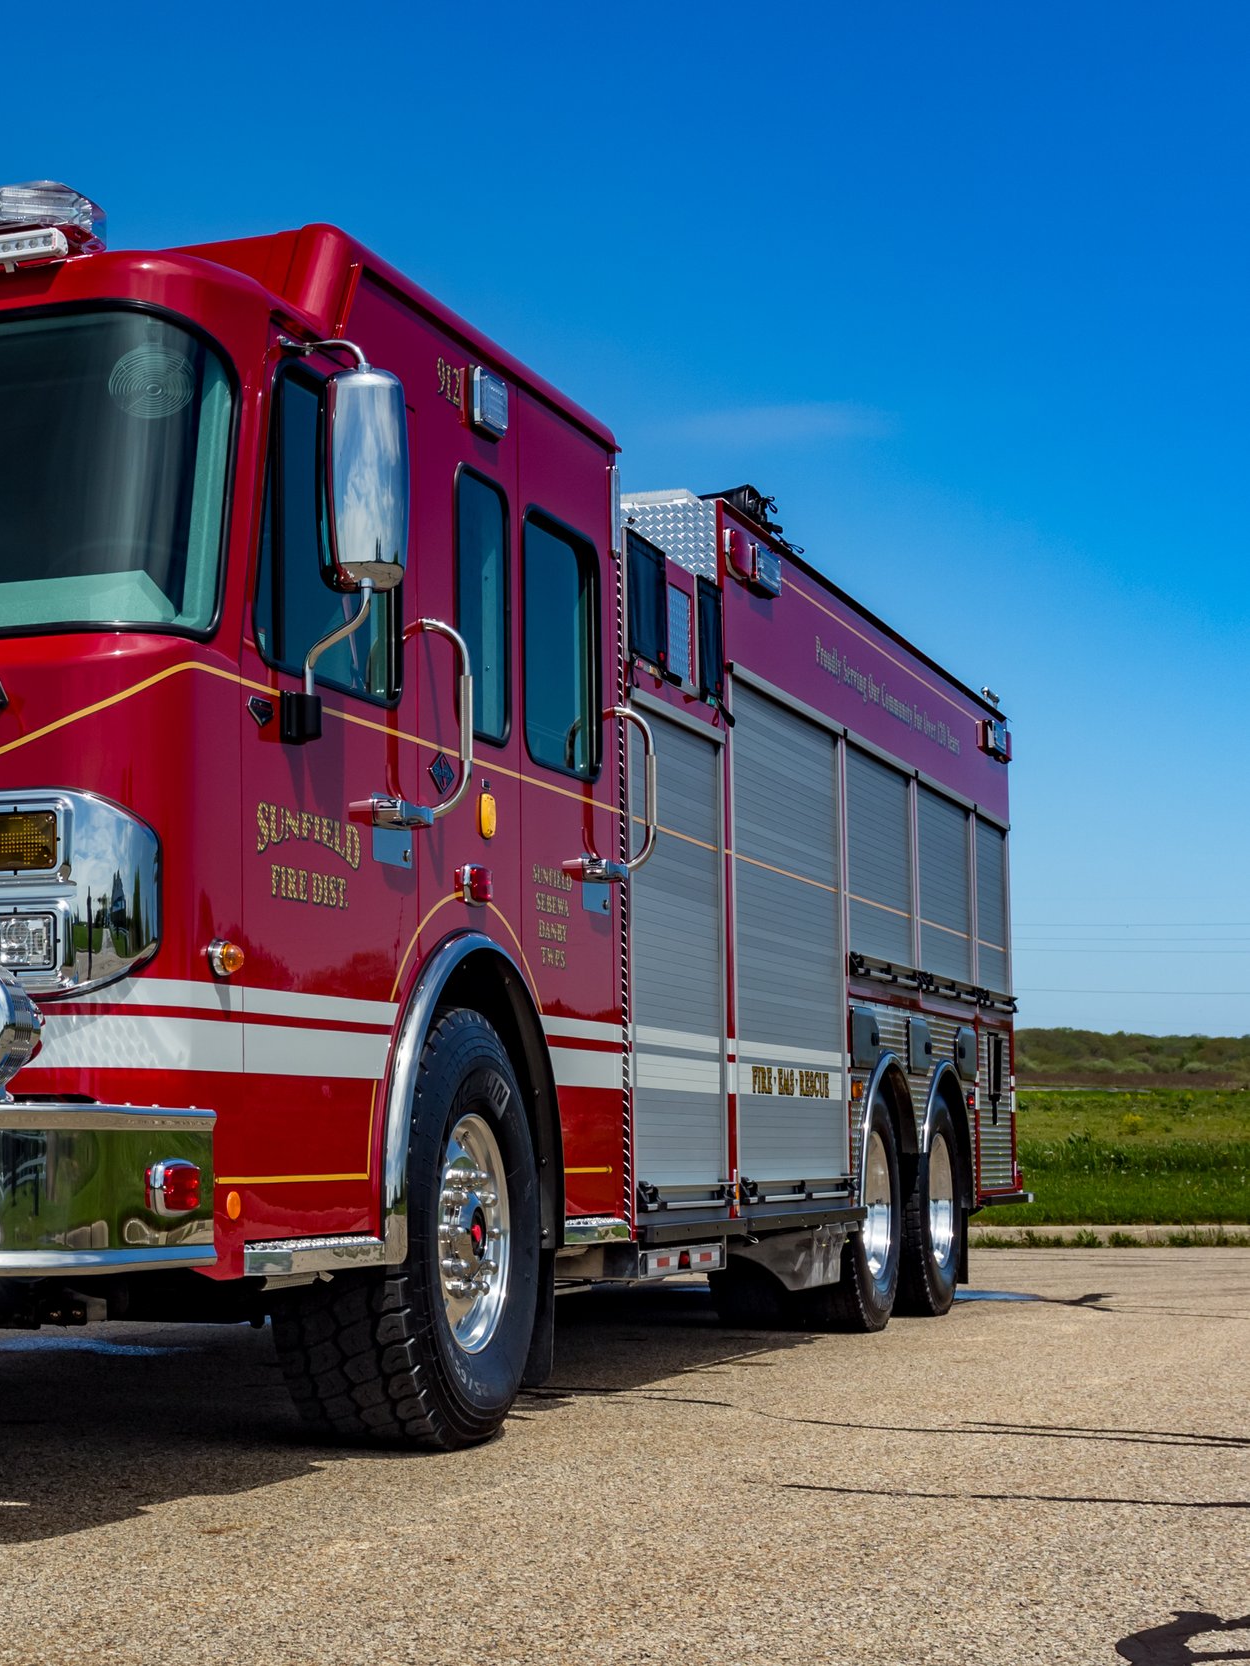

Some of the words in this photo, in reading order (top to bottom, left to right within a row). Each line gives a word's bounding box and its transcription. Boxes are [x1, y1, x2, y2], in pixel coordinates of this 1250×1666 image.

[437, 357, 460, 407] 912
[256, 801, 361, 871] SUNFIELD
[271, 864, 308, 902] FIRE
[312, 872, 349, 910] DIST.
[532, 863, 573, 892] SUNFIELD
[535, 892, 570, 917] SEBEWA
[538, 919, 567, 943] DANBY
[540, 946, 566, 970] TWPS
[751, 1065, 773, 1095] FIRE
[777, 1068, 795, 1096] EMS
[798, 1070, 830, 1099] RESCUE
